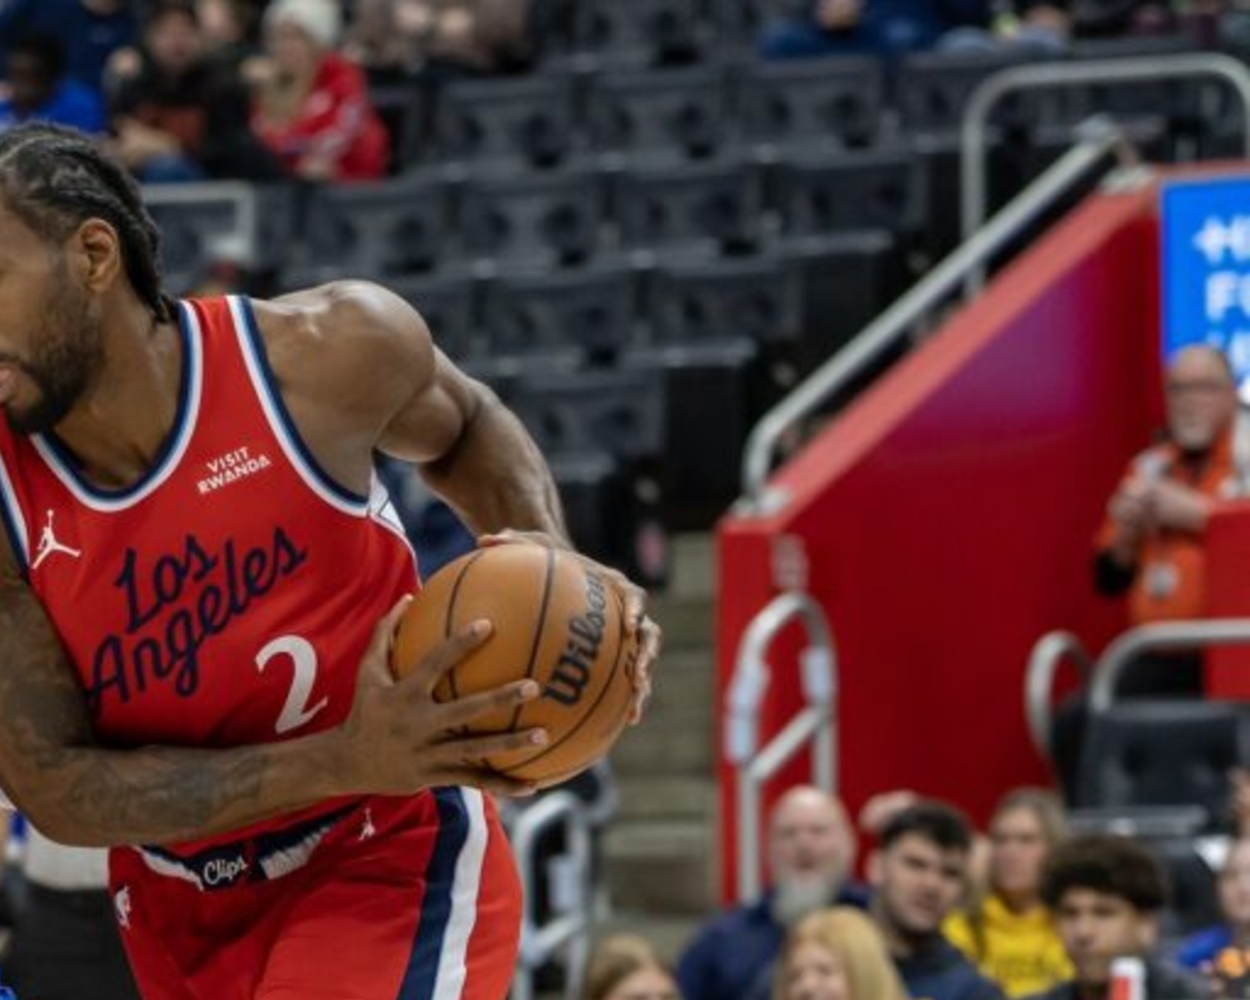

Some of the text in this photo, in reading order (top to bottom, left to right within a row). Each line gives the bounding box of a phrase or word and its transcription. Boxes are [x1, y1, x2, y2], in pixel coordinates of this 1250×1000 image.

[197, 453, 272, 495] RWANDA
[206, 446, 249, 473] VISIT
[85, 525, 307, 703] Angeles
[115, 533, 218, 634] Los
[255, 635, 328, 735] 2
[203, 855, 249, 885] Clips
